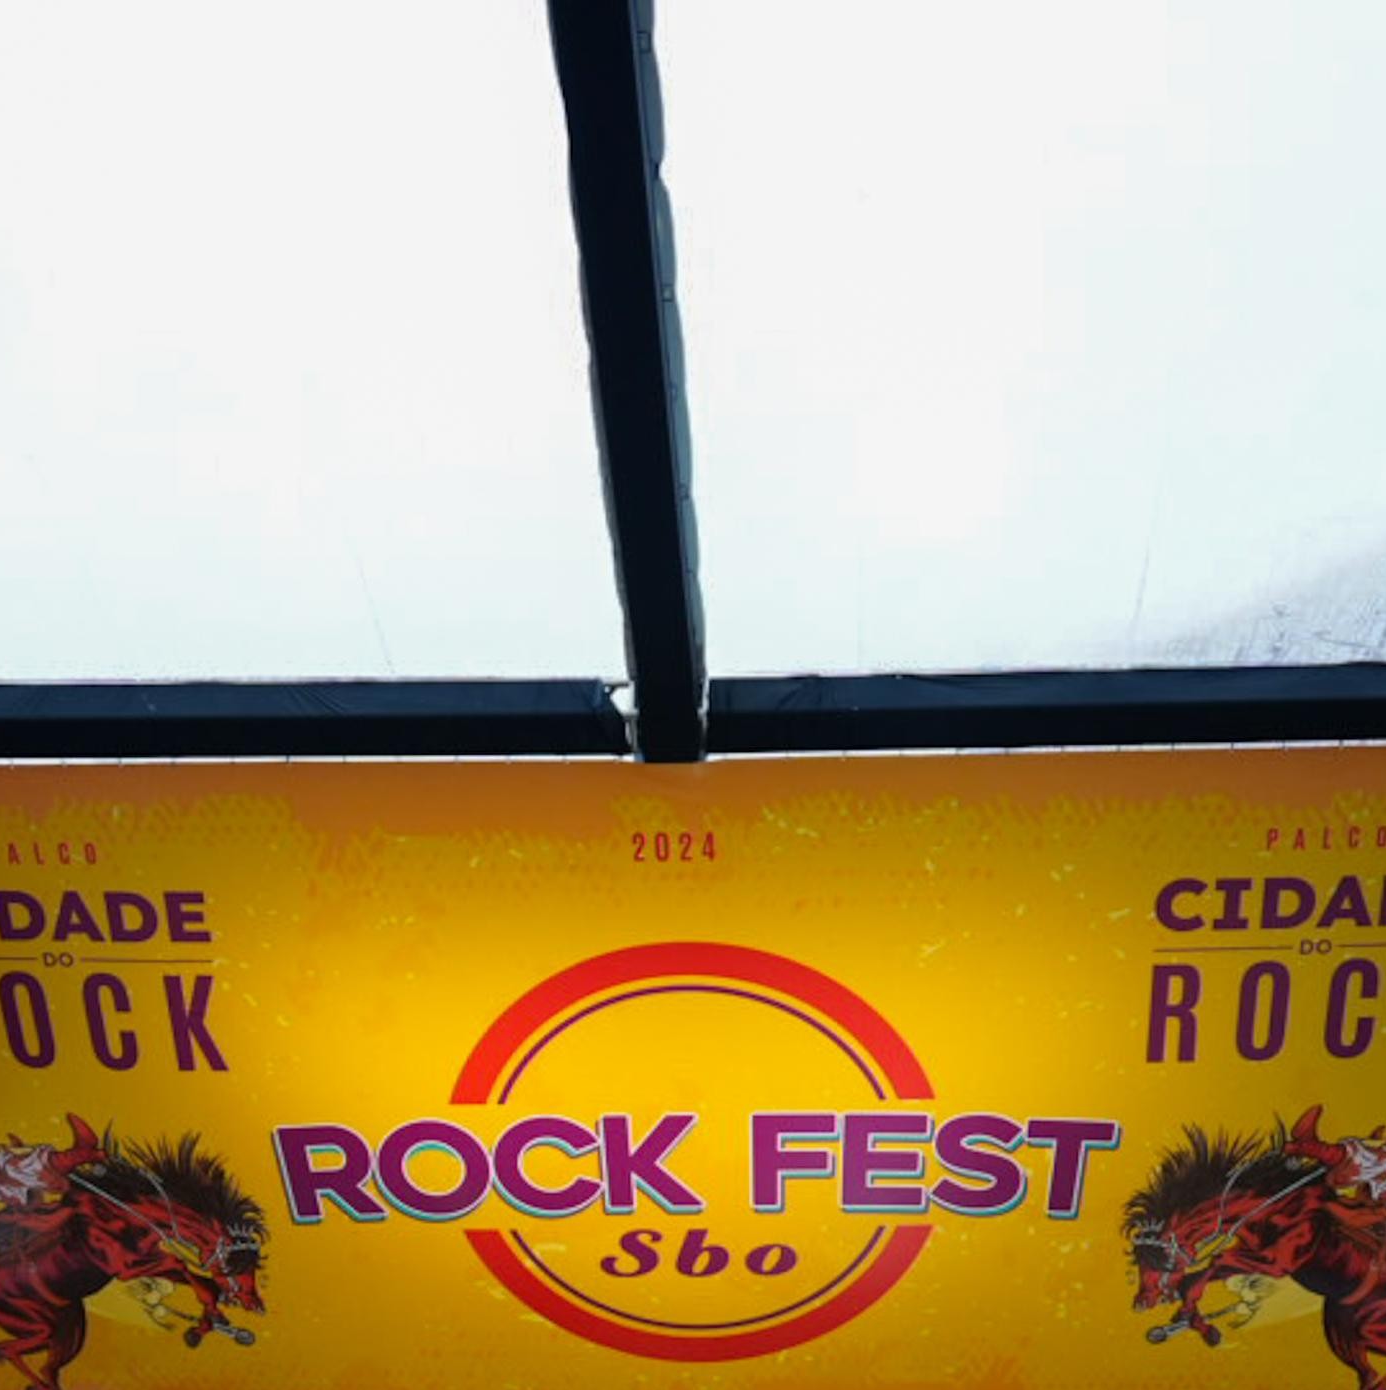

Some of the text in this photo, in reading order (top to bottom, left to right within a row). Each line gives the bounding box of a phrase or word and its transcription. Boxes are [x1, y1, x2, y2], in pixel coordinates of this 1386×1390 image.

[631, 831, 715, 862] 2024
[42, 952, 74, 968] DO
[1300, 939, 1332, 955] DO
[272, 1111, 1121, 1222] ROCK FEST
[599, 1228, 798, 1278] Sbo
